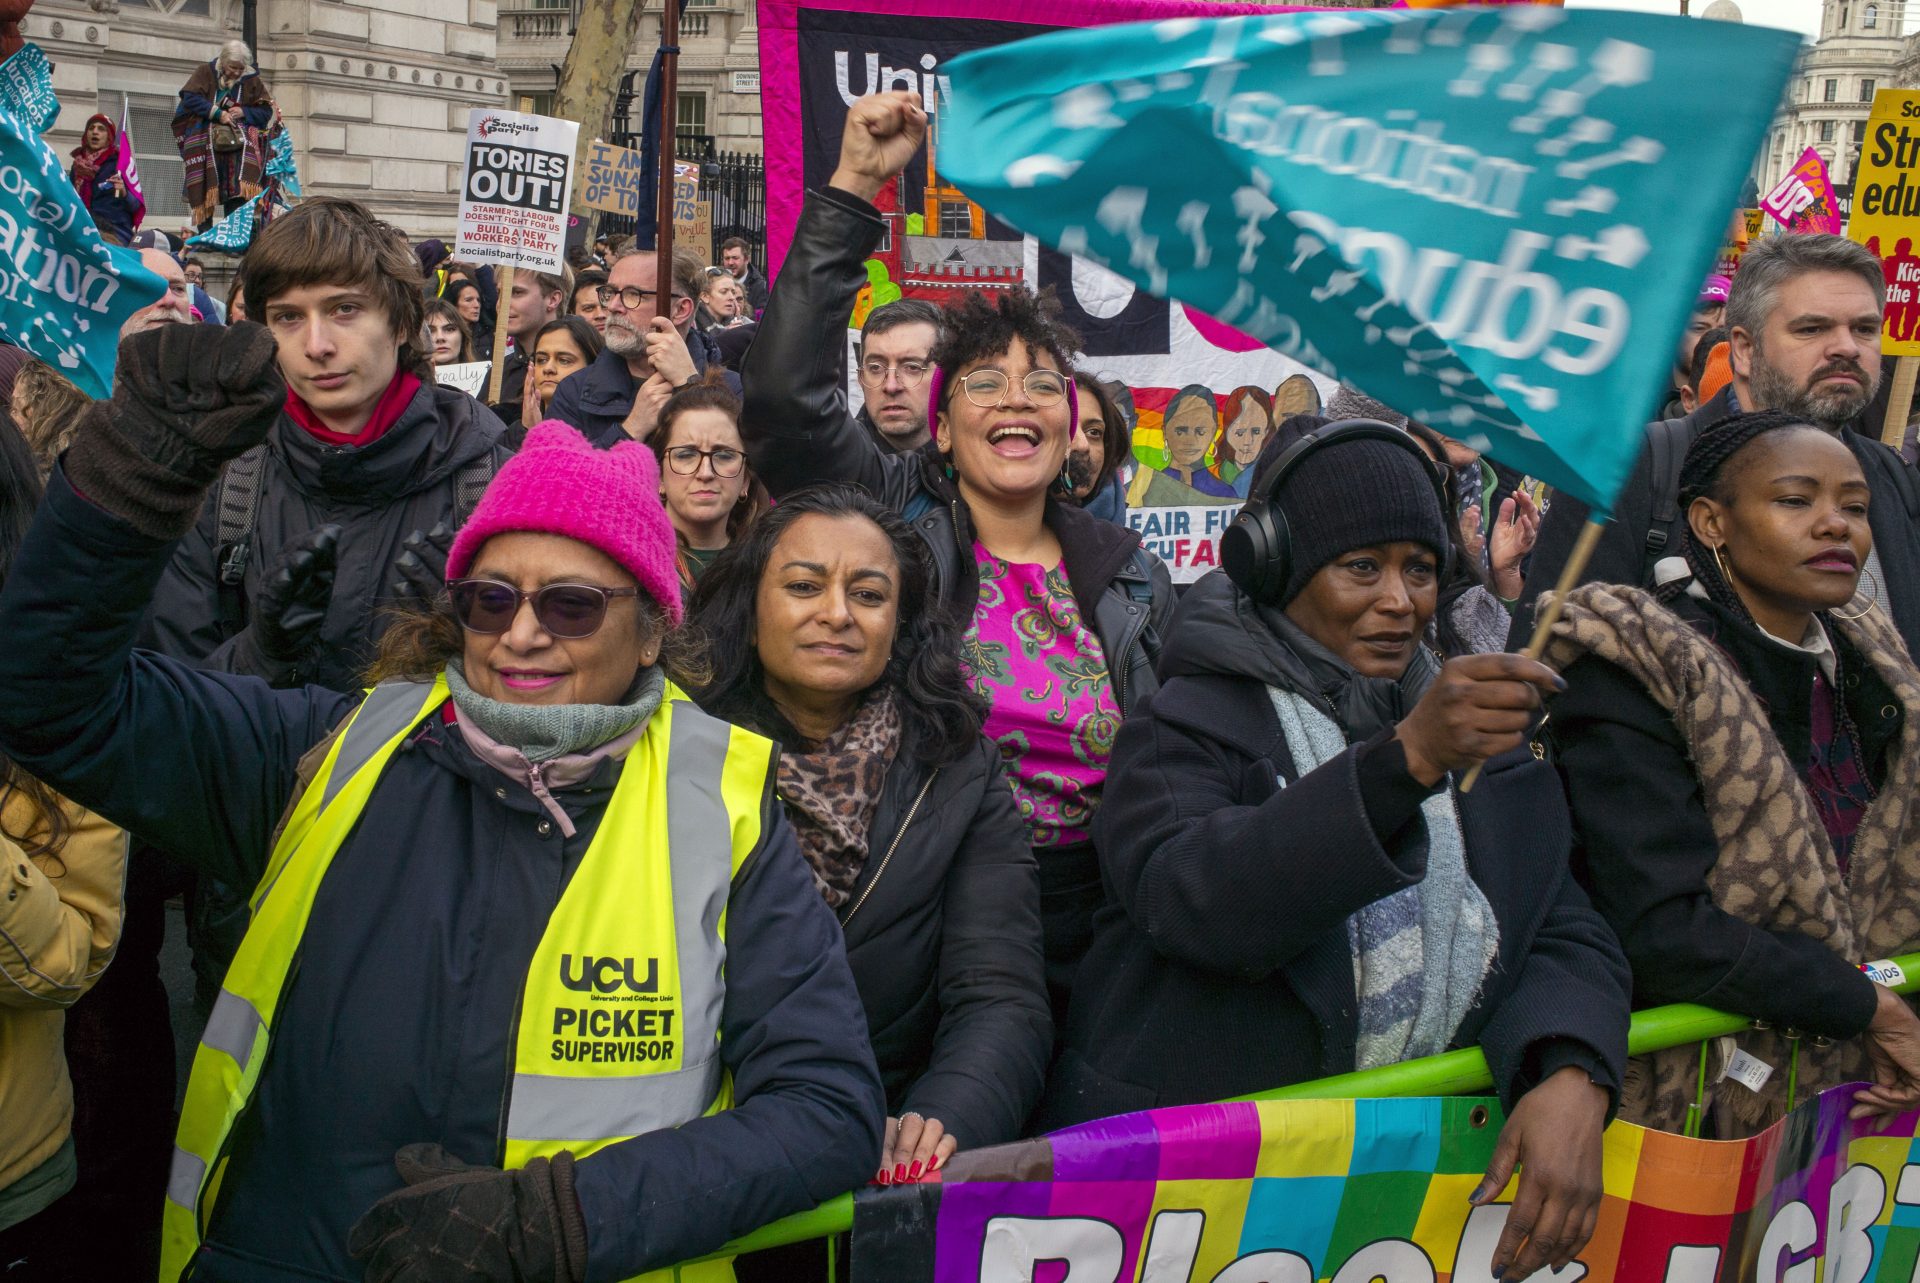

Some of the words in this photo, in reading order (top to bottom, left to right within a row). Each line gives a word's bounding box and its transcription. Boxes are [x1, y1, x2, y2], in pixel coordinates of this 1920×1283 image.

[20, 59, 45, 99] national
[491, 118, 539, 133] Socialist
[472, 146, 565, 178] TORIES
[590, 145, 611, 167] I
[587, 165, 640, 190] SUNA
[470, 169, 562, 209] OUT!
[585, 185, 611, 204] OF
[465, 212, 502, 222] DOESN'T
[504, 216, 529, 227] FIGHT
[530, 220, 547, 229] FOR
[548, 224, 560, 232] US
[472, 205, 520, 217] STARMER'S
[521, 211, 555, 223] LABOUR
[477, 224, 510, 235] BUILD
[512, 228, 520, 237] A
[522, 229, 547, 241] NEW
[680, 221, 708, 236] VALUE
[1745, 220, 1761, 234] for
[464, 231, 521, 245] WORKERS'
[523, 238, 558, 253] PARTY
[460, 247, 556, 267] socialistparty.org.uk
[1886, 284, 1911, 304] the
[436, 365, 482, 391] really
[1130, 511, 1190, 538] FAIR
[1206, 509, 1242, 535] FU
[559, 953, 658, 993] UCU
[591, 994, 620, 1002] University
[553, 1007, 675, 1038] PICKET
[551, 1039, 674, 1062] SUPERVISOR
